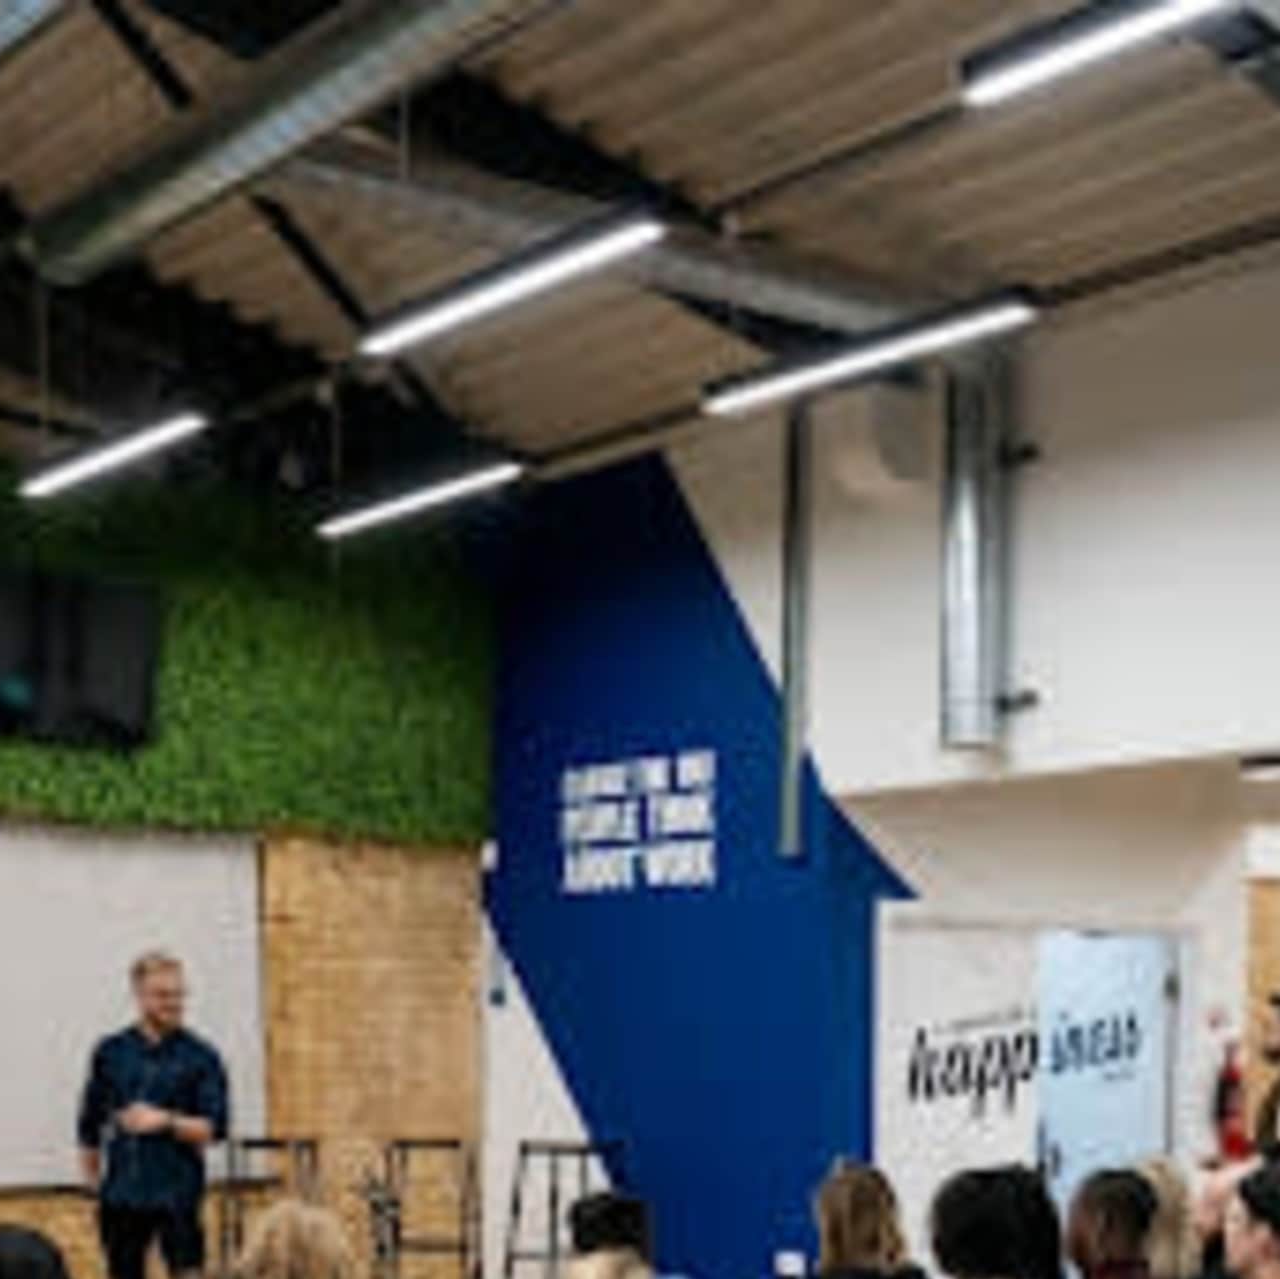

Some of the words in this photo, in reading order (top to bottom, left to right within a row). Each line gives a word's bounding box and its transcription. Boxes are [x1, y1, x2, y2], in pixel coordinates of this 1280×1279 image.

[563, 801, 640, 841] PEOPLE
[563, 846, 639, 892] ABOUT
[642, 838, 717, 886] WORK
